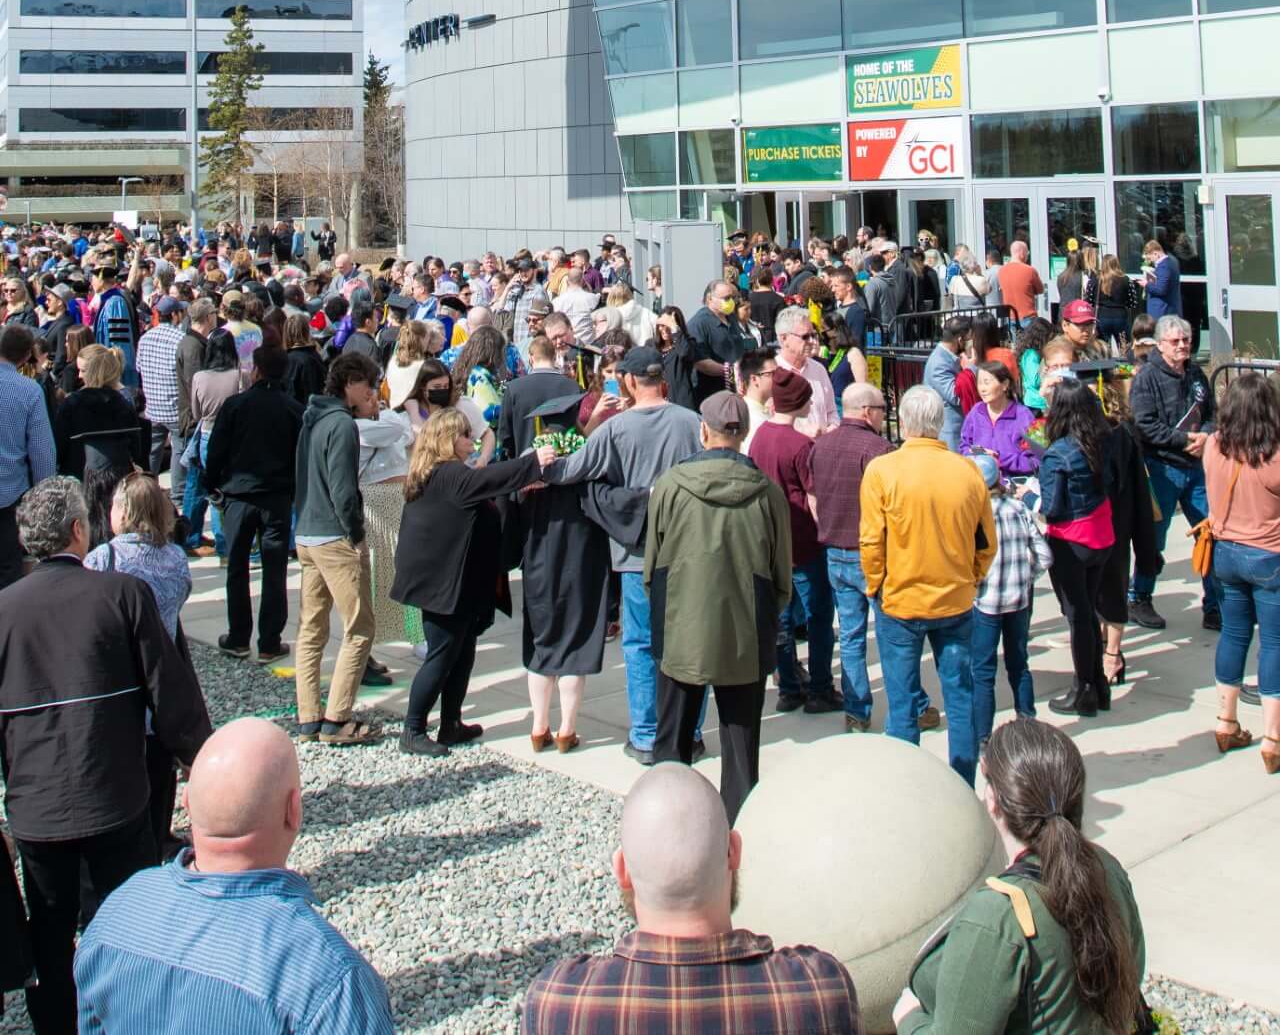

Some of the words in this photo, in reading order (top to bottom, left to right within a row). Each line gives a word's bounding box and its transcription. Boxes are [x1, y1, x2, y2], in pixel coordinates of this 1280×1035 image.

[854, 62, 880, 76] HOME
[882, 60, 895, 74] OF
[896, 59, 915, 72] THE
[855, 74, 953, 105] SEAWOLVES
[855, 127, 897, 141] POWERED
[748, 147, 800, 161] PURCHASE
[800, 145, 842, 159] TICKETS
[855, 146, 867, 158] BY
[908, 143, 955, 175] GCI
